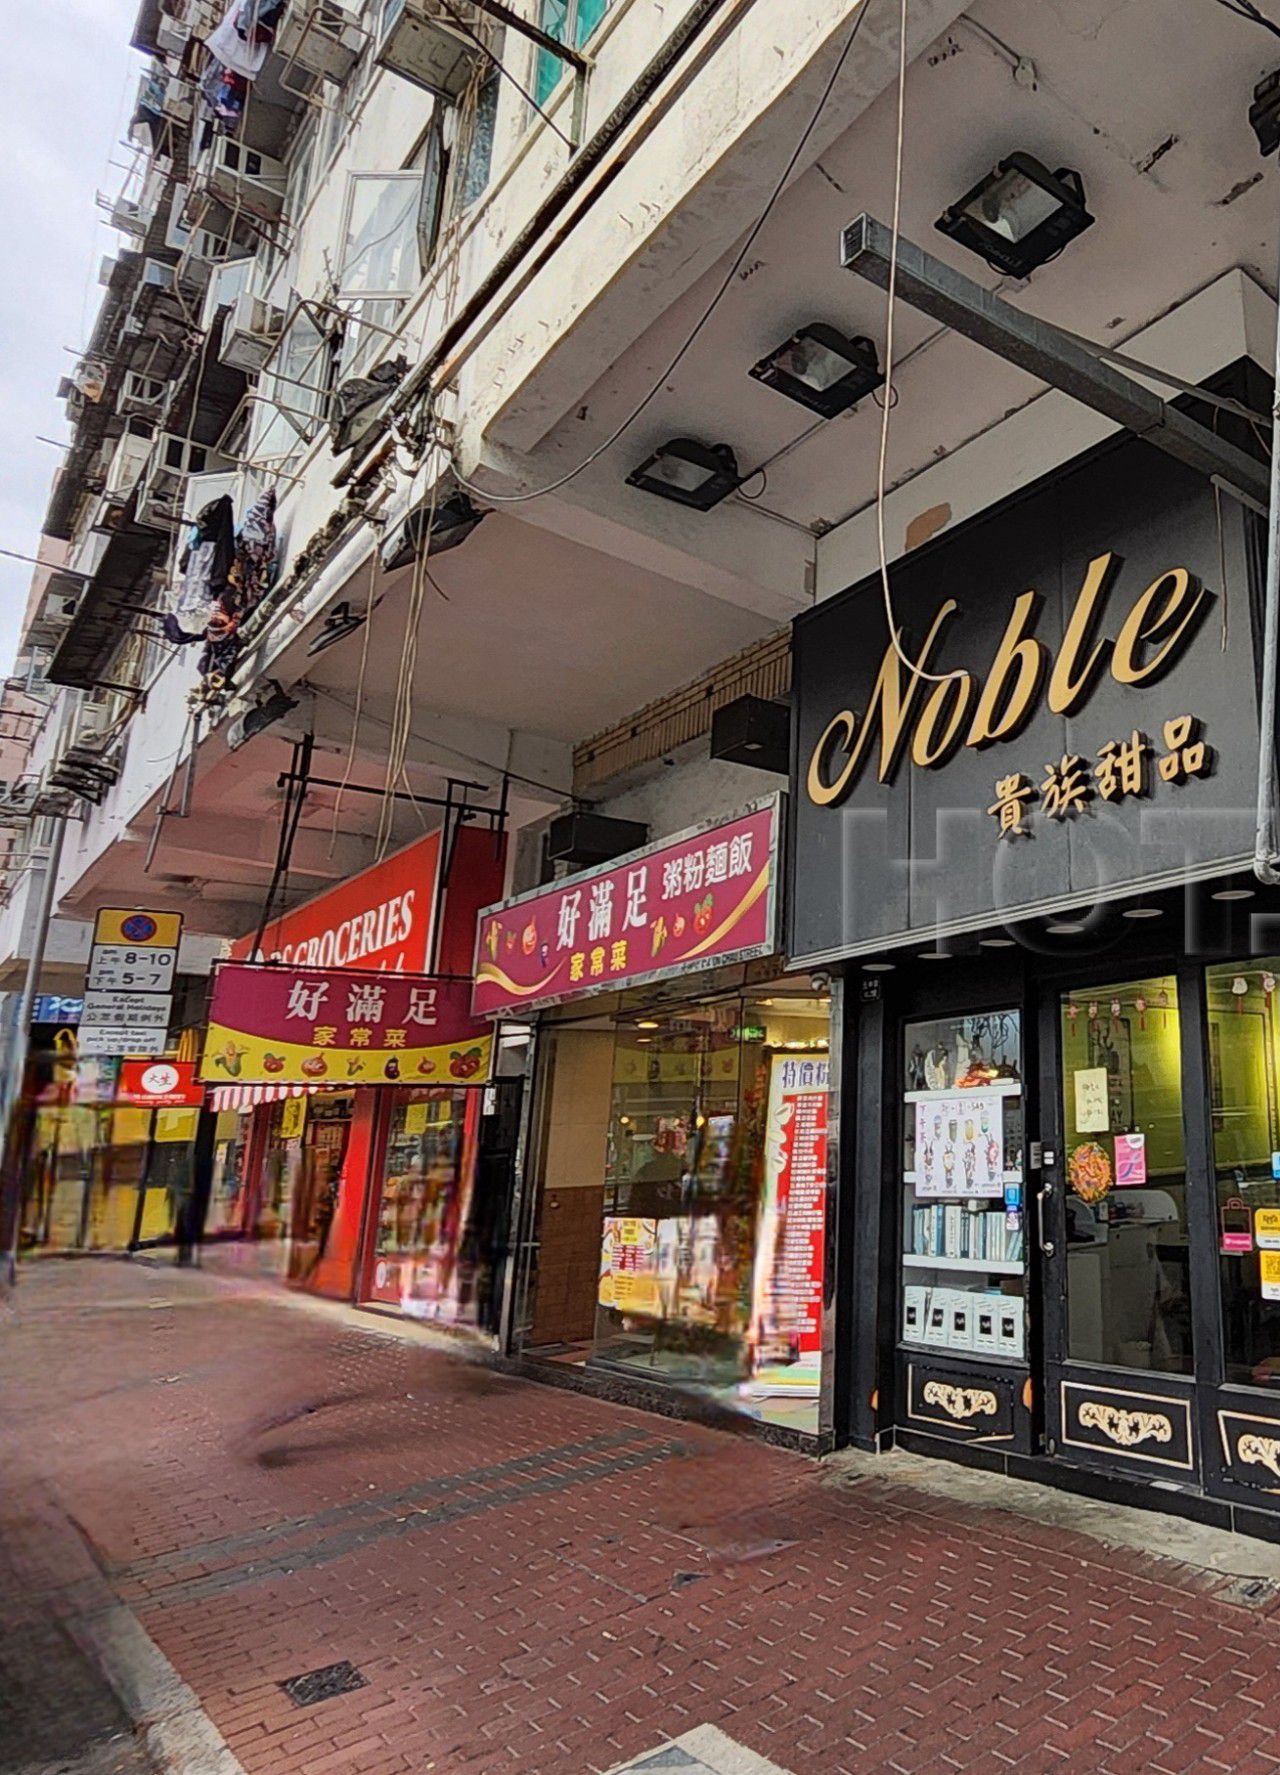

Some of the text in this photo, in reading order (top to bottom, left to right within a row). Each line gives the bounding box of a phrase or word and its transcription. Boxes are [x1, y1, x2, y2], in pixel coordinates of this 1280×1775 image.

[807, 552, 1206, 806] Noble
[987, 714, 1206, 840] 貴族甜品
[556, 832, 753, 951] 好滿足 粥粉麵飯
[291, 889, 416, 967] GROCERIES
[124, 952, 171, 966] 8-10
[570, 939, 628, 982] 家常菜
[285, 980, 438, 1025] 好滿足
[313, 1026, 408, 1048] 家常菜
